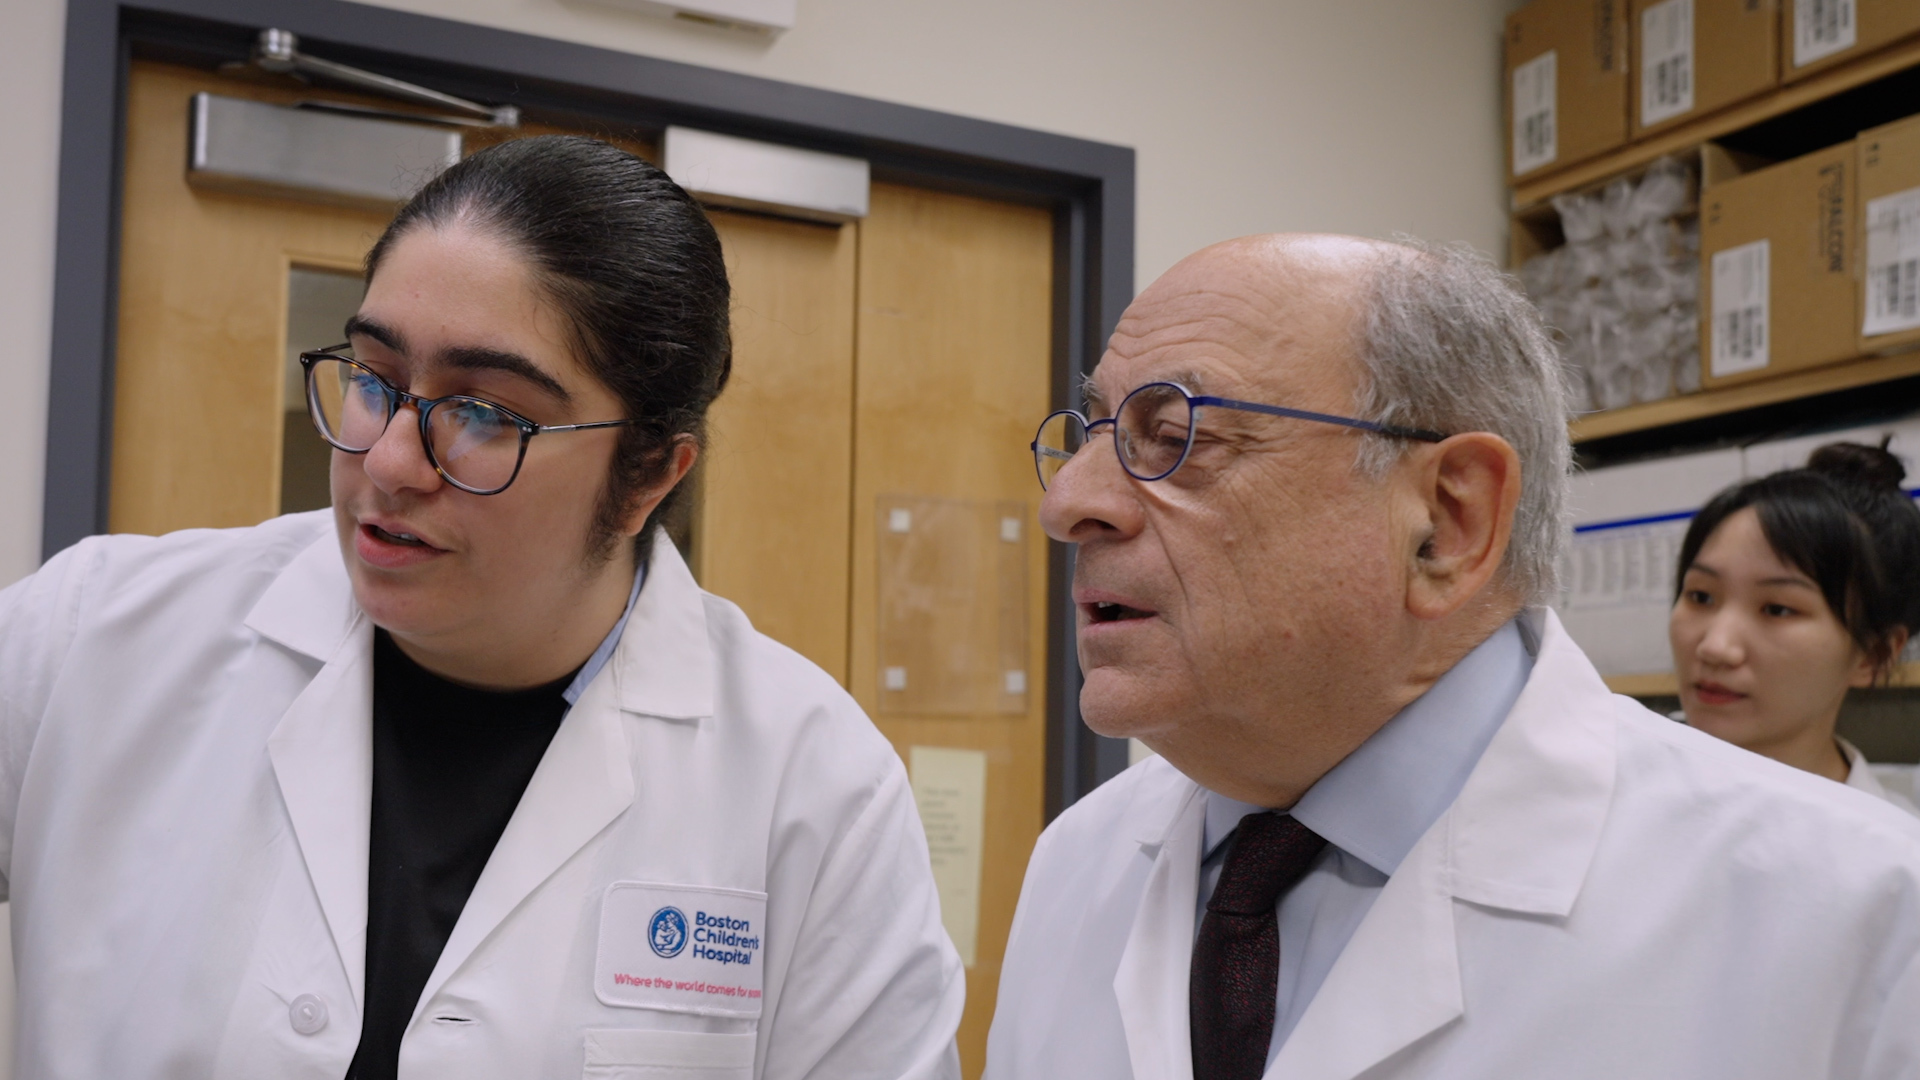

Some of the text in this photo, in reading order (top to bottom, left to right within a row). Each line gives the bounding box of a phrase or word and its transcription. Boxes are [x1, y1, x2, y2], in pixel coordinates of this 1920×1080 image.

[695, 911, 750, 932] Boston
[693, 944, 752, 965] Hospital
[614, 973, 652, 988] Where
[654, 977, 673, 989] the
[675, 980, 705, 993] world
[706, 985, 736, 996] comes
[737, 986, 747, 998] for
